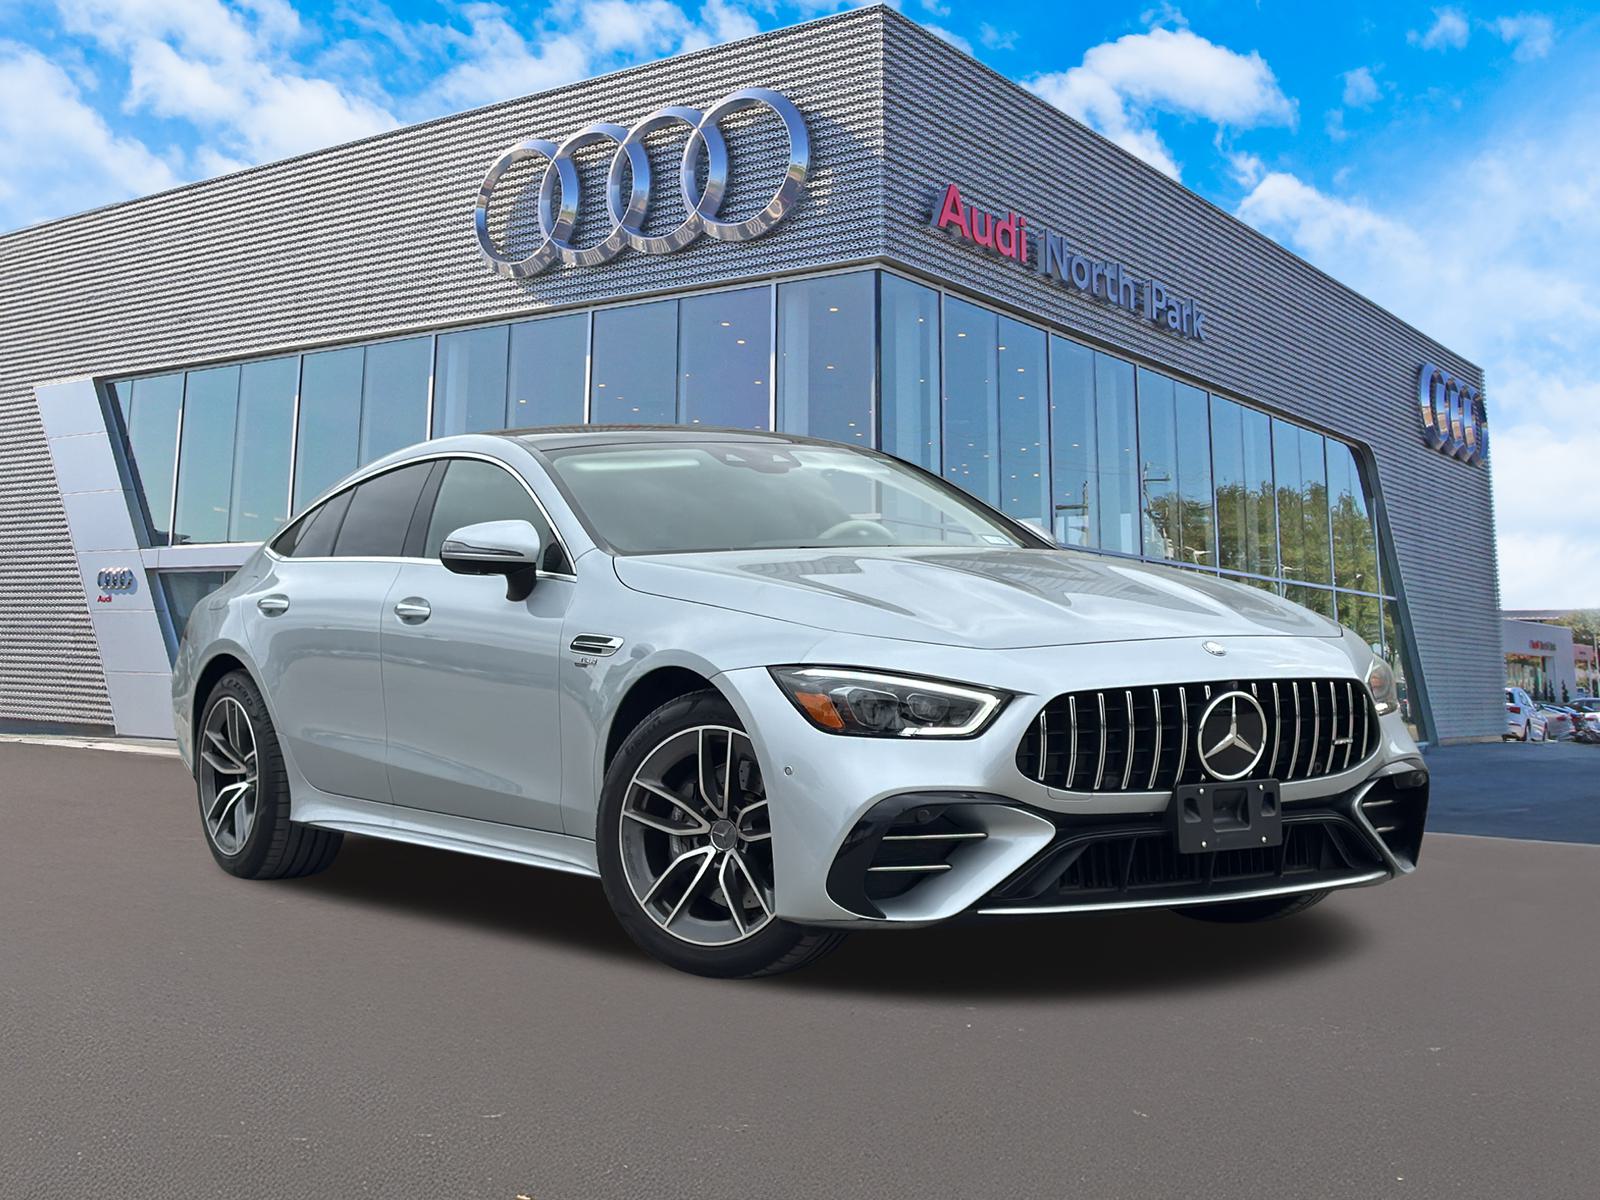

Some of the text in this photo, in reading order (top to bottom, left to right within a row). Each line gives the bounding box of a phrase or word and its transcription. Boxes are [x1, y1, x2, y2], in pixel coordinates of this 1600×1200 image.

[935, 184, 1207, 340] Audi North Park
